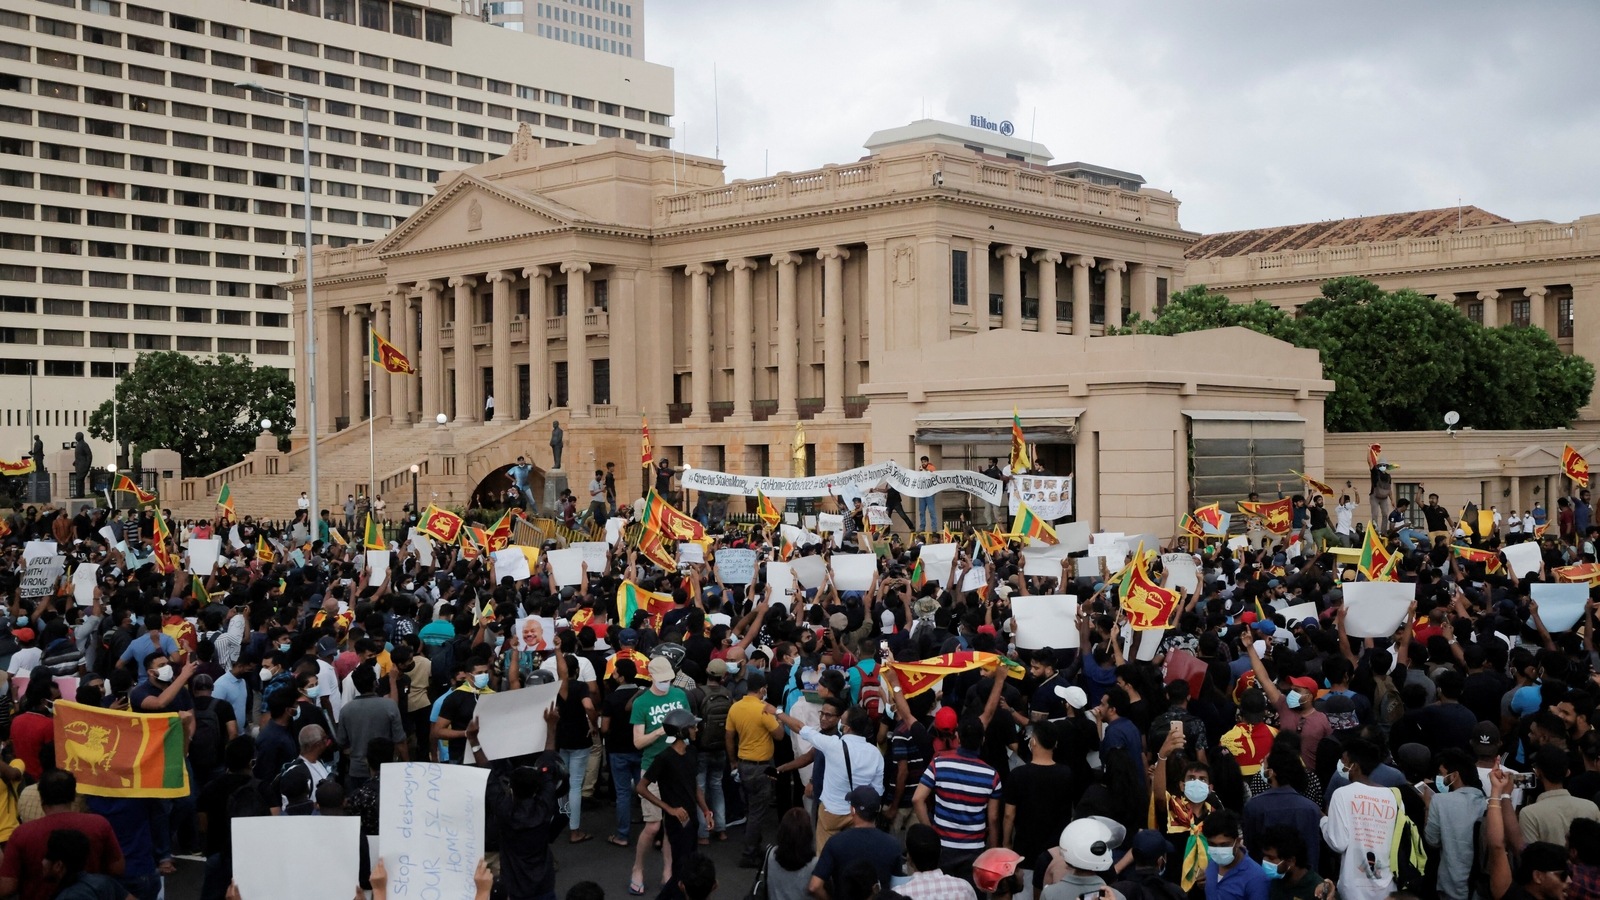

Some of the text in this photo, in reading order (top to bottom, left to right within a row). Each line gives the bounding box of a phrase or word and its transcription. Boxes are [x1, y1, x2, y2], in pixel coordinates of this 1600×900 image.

[970, 115, 997, 131] Hilton
[34, 556, 53, 565] FUCK
[21, 577, 48, 586] WRONG
[1354, 794, 1380, 803] LOSING
[1351, 801, 1395, 819] MIND
[394, 855, 418, 897] Stop
[420, 857, 442, 900] OUR
